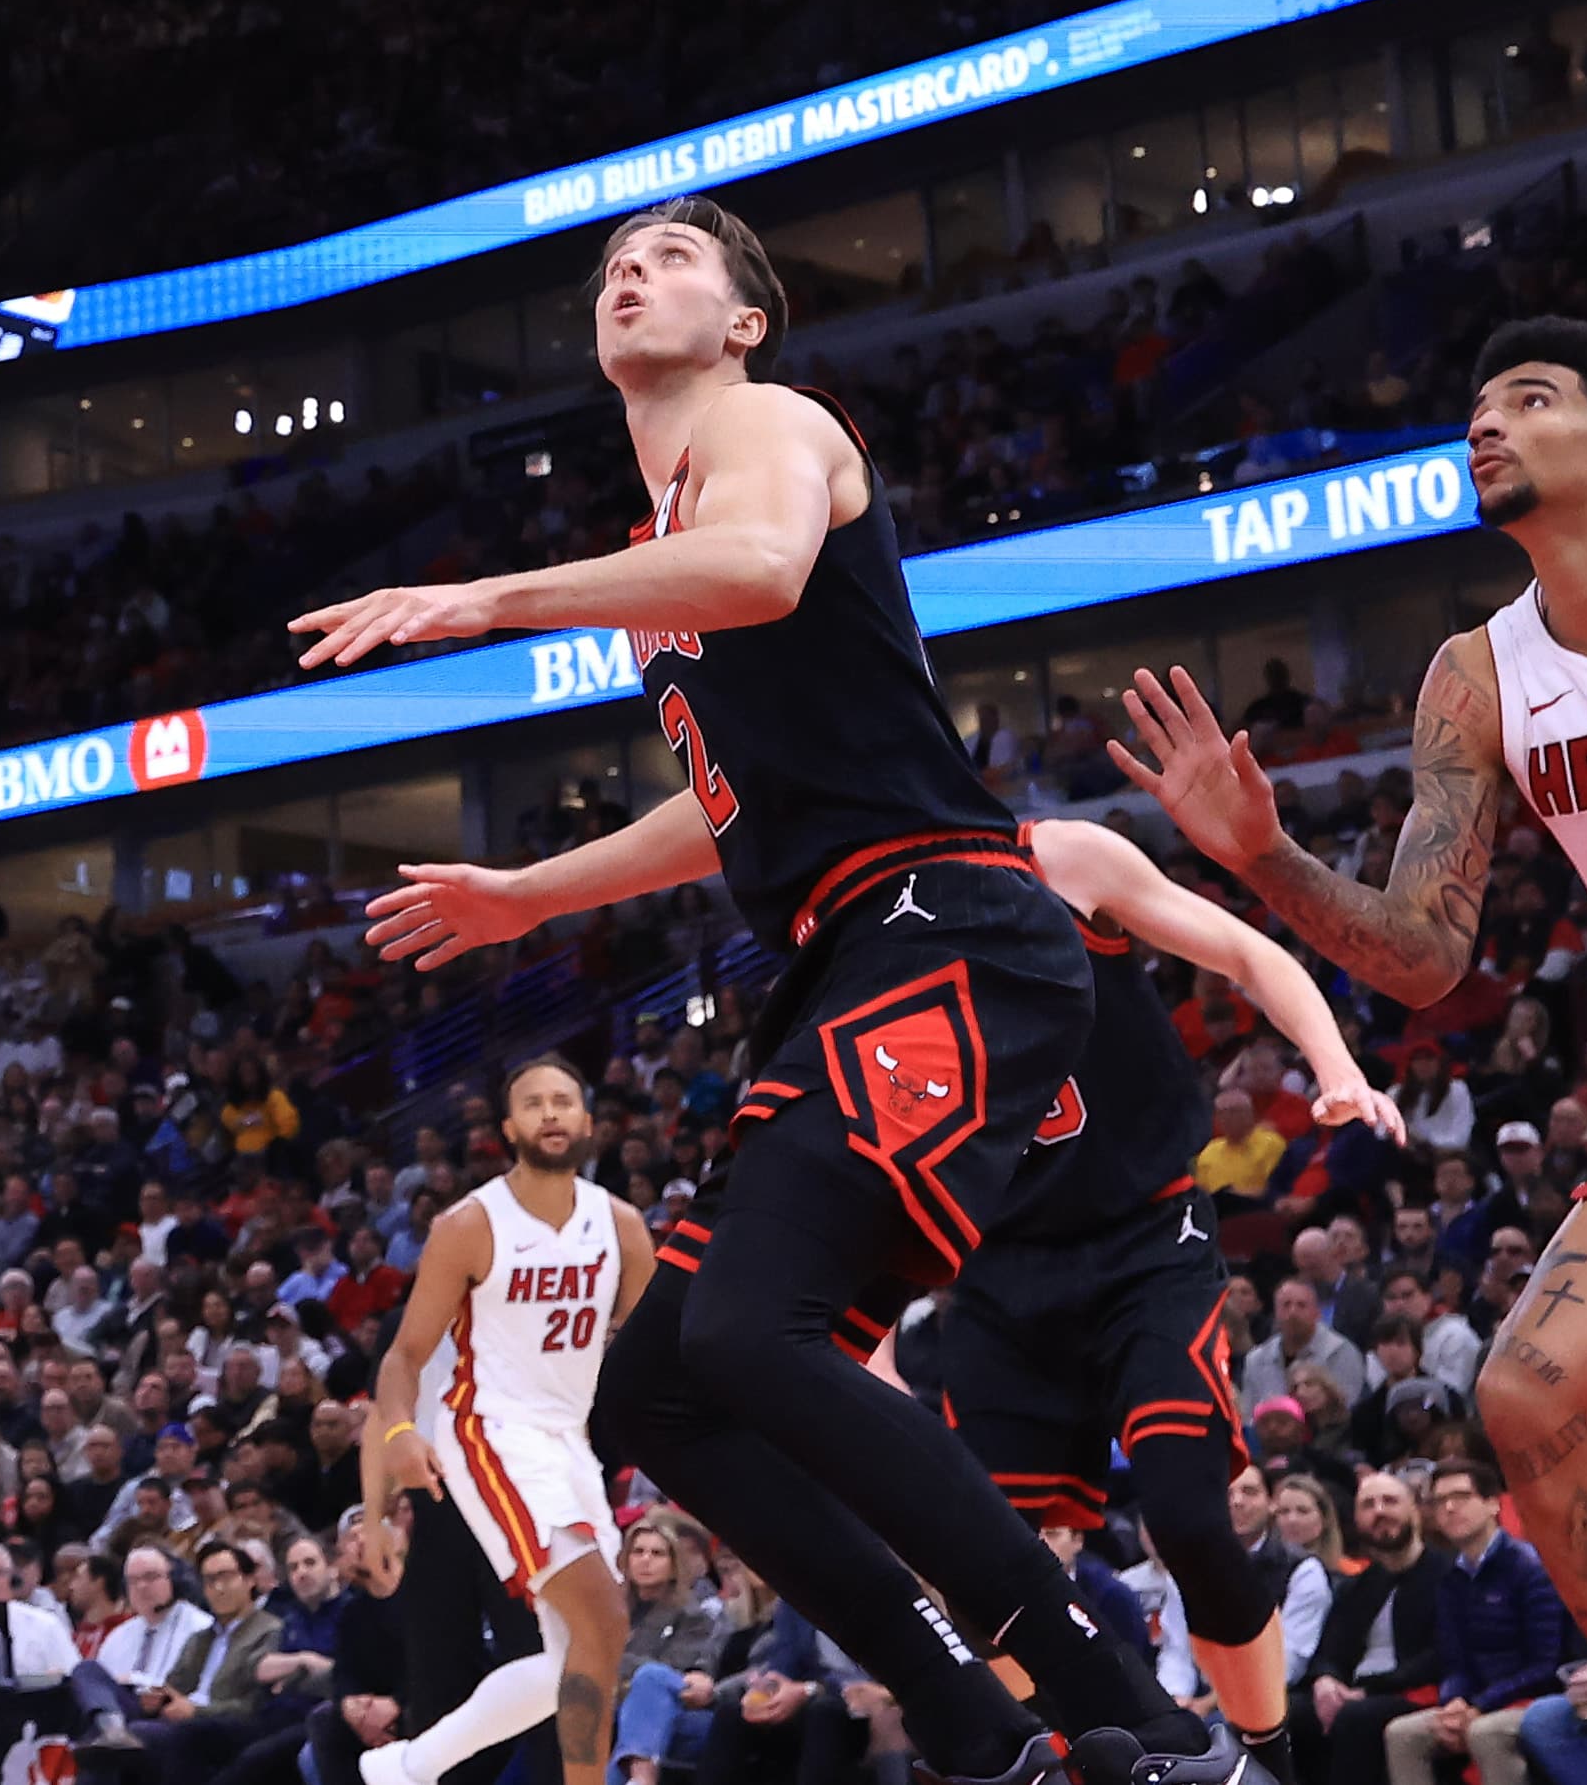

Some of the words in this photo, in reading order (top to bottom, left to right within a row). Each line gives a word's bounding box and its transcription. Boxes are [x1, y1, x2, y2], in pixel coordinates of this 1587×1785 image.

[526, 173, 595, 225] BMO
[603, 142, 696, 205] BULLS
[703, 113, 799, 175] DEBIT
[1201, 488, 1312, 566] TAP
[1327, 457, 1461, 541] INTO
[530, 627, 644, 705] BM
[658, 682, 741, 839] 2
[506, 1248, 608, 1304] HEAT
[541, 1306, 598, 1354] 20
